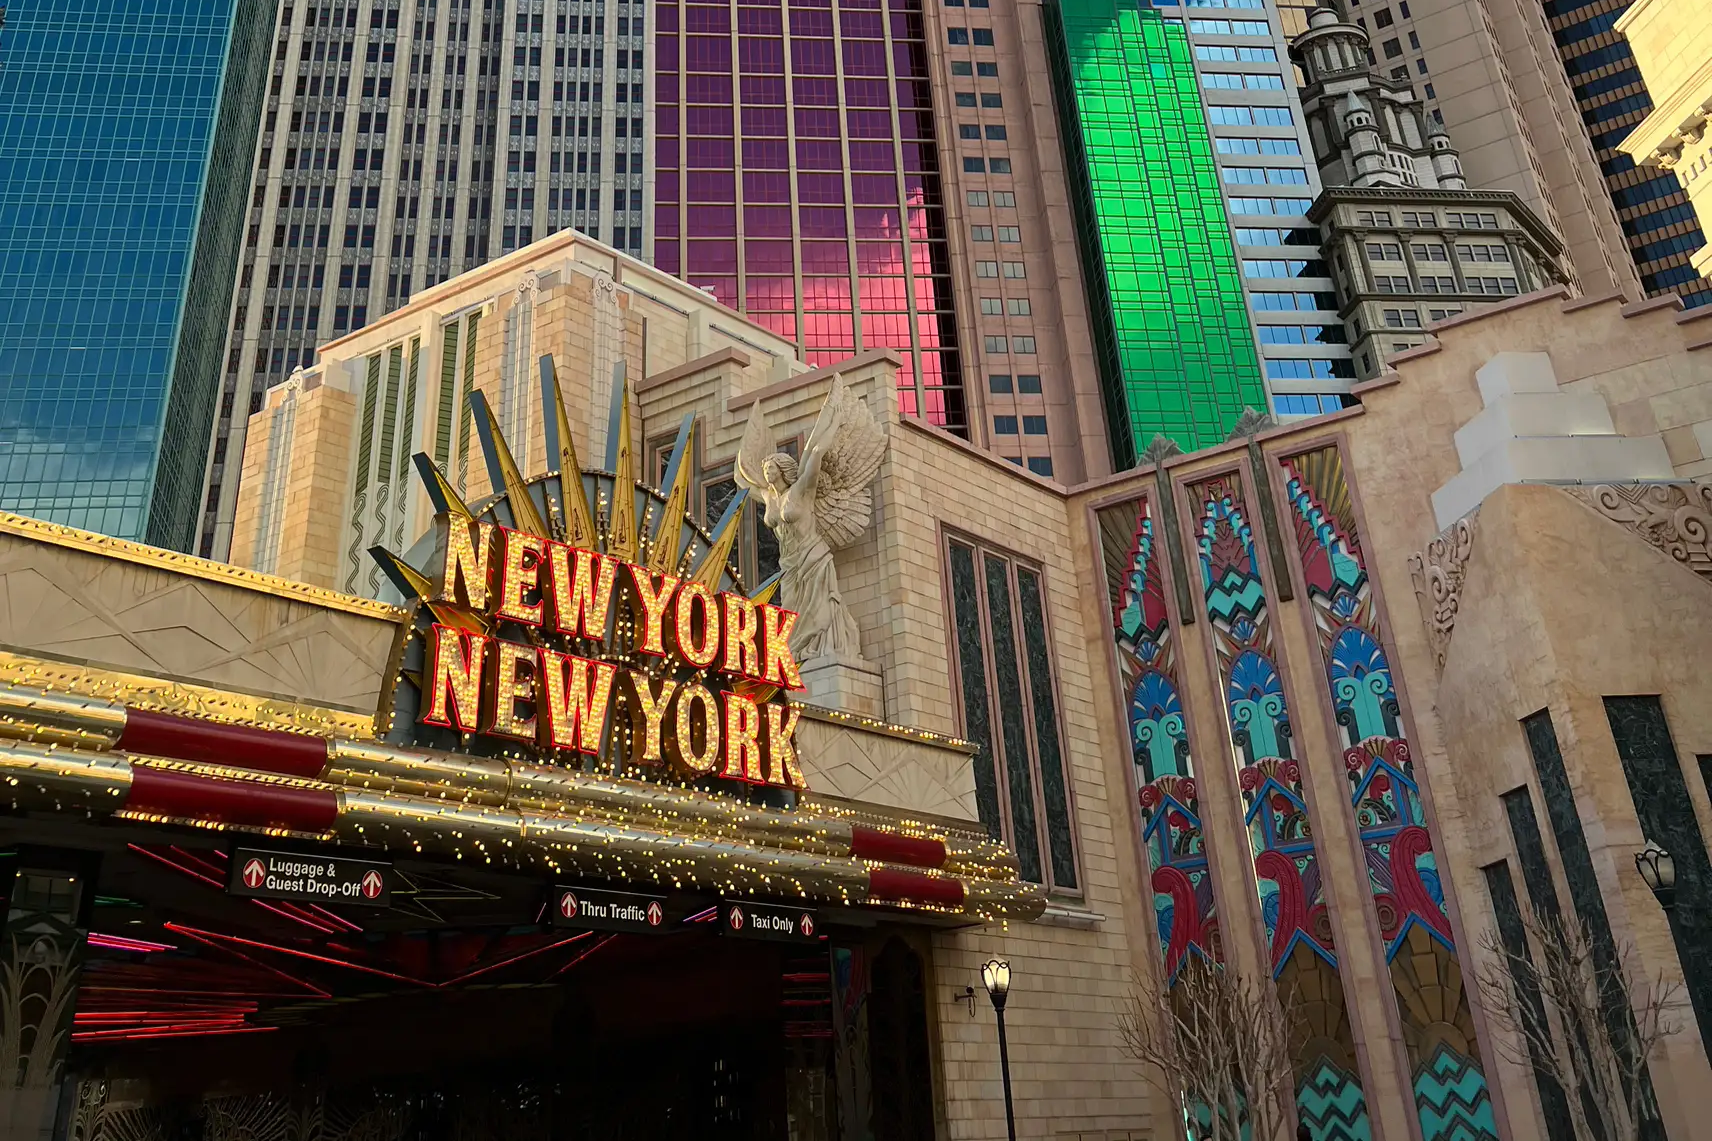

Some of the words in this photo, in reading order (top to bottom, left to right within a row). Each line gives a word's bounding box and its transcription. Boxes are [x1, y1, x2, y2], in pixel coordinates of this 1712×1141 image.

[441, 512, 619, 641] NEW
[624, 563, 806, 692] YORK
[423, 623, 618, 756] NEW
[627, 669, 808, 790] YORK
[269, 858, 324, 878] Luggage
[326, 863, 336, 877] &
[266, 875, 304, 892] Guest
[306, 878, 361, 898] Drop-Off
[580, 900, 607, 918] Thru
[610, 903, 645, 922] Traffic
[751, 913, 770, 930] Taxi
[772, 916, 794, 935] Only
